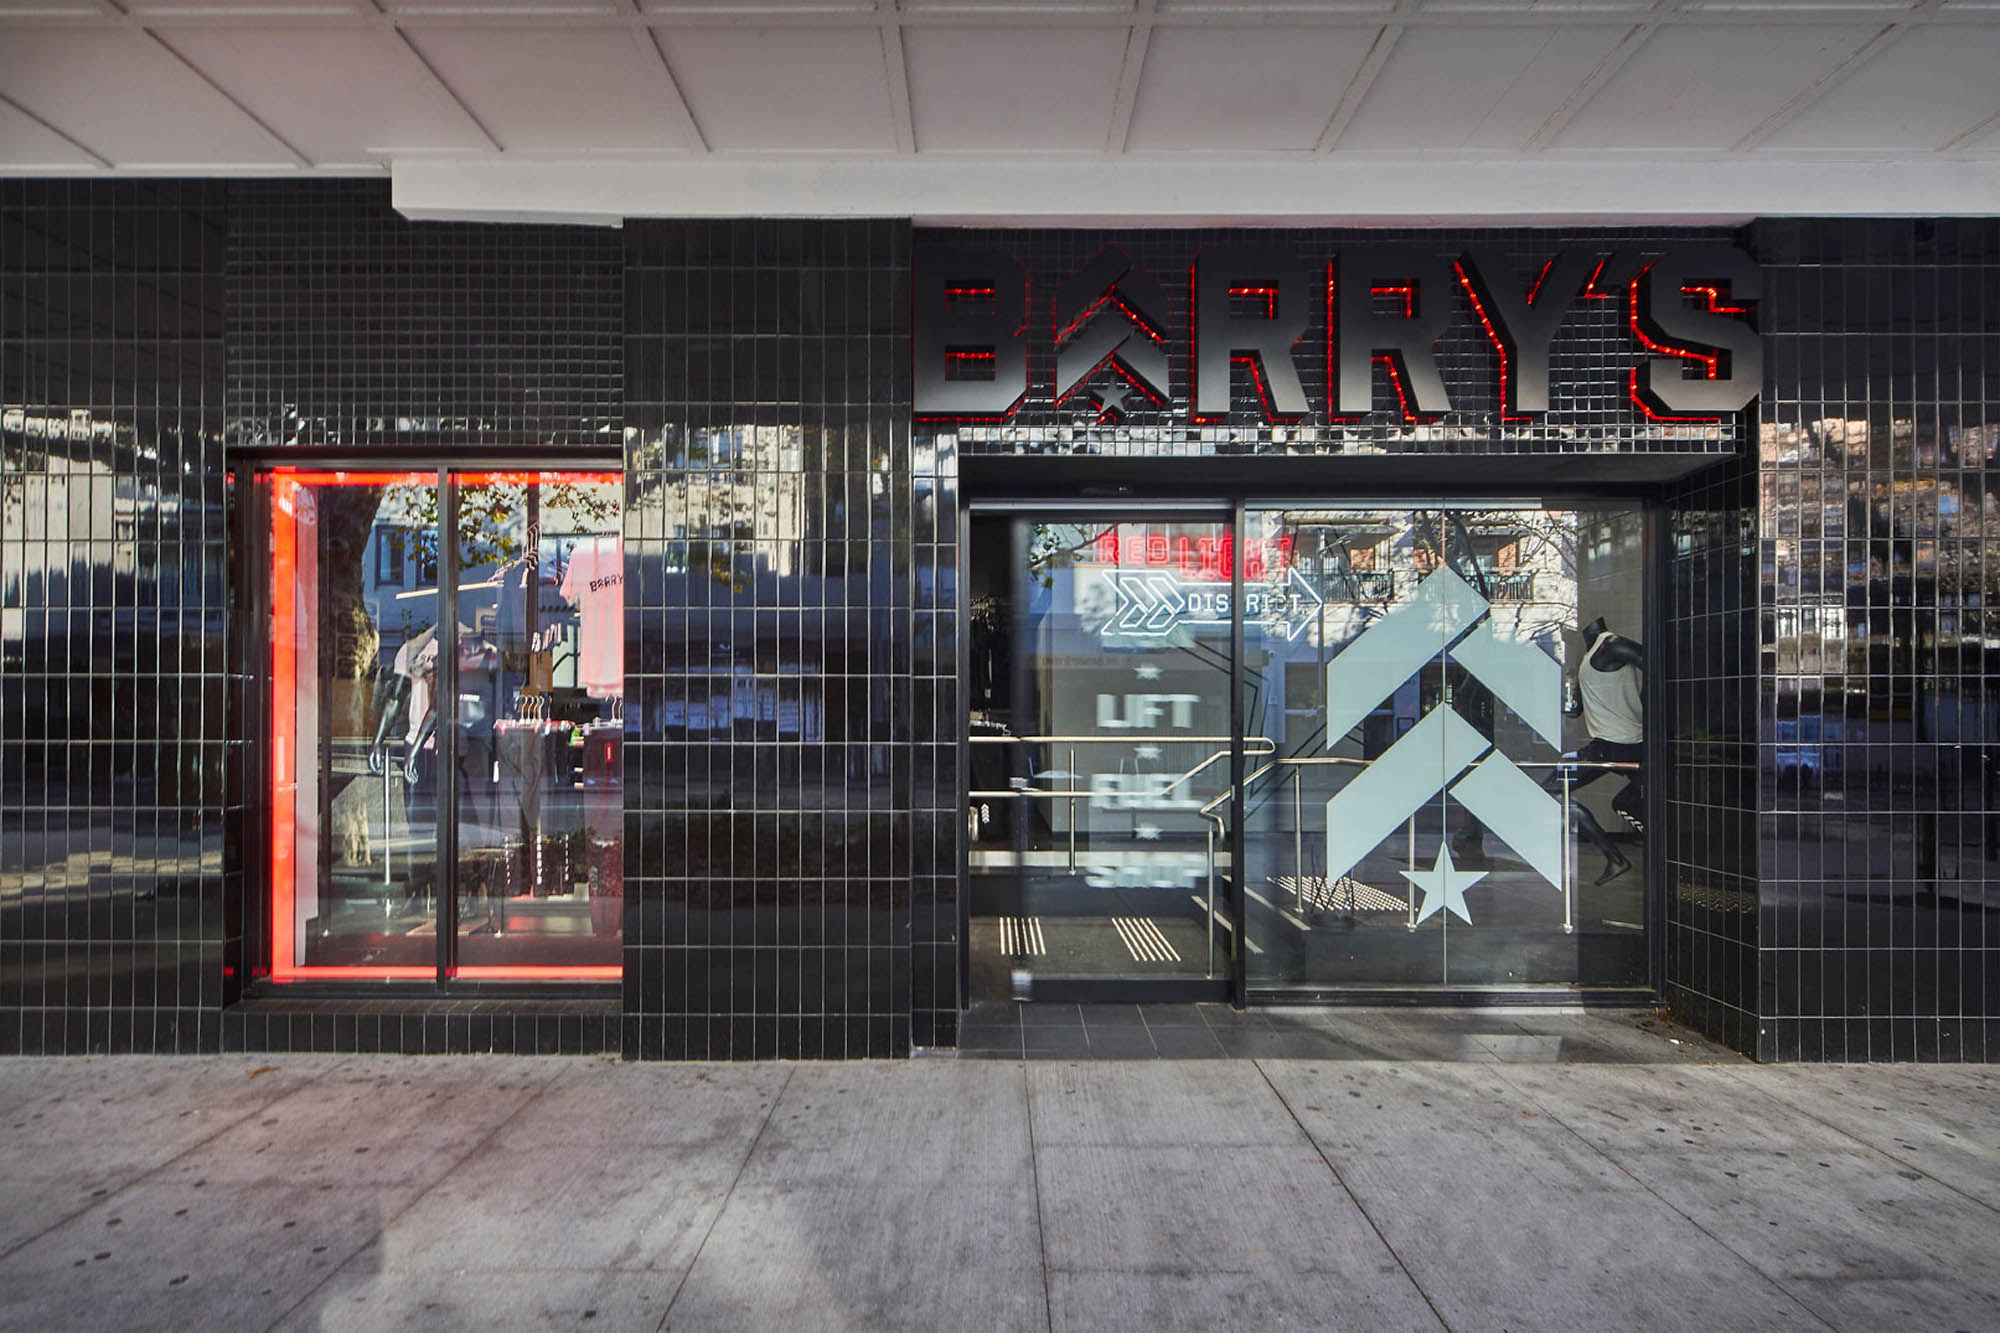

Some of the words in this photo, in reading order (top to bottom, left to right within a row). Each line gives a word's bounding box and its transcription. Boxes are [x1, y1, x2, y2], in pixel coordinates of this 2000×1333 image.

[1098, 535, 1170, 565] RED
[1178, 536, 1292, 580] LIGHT
[1188, 593, 1302, 613] DISRICT
